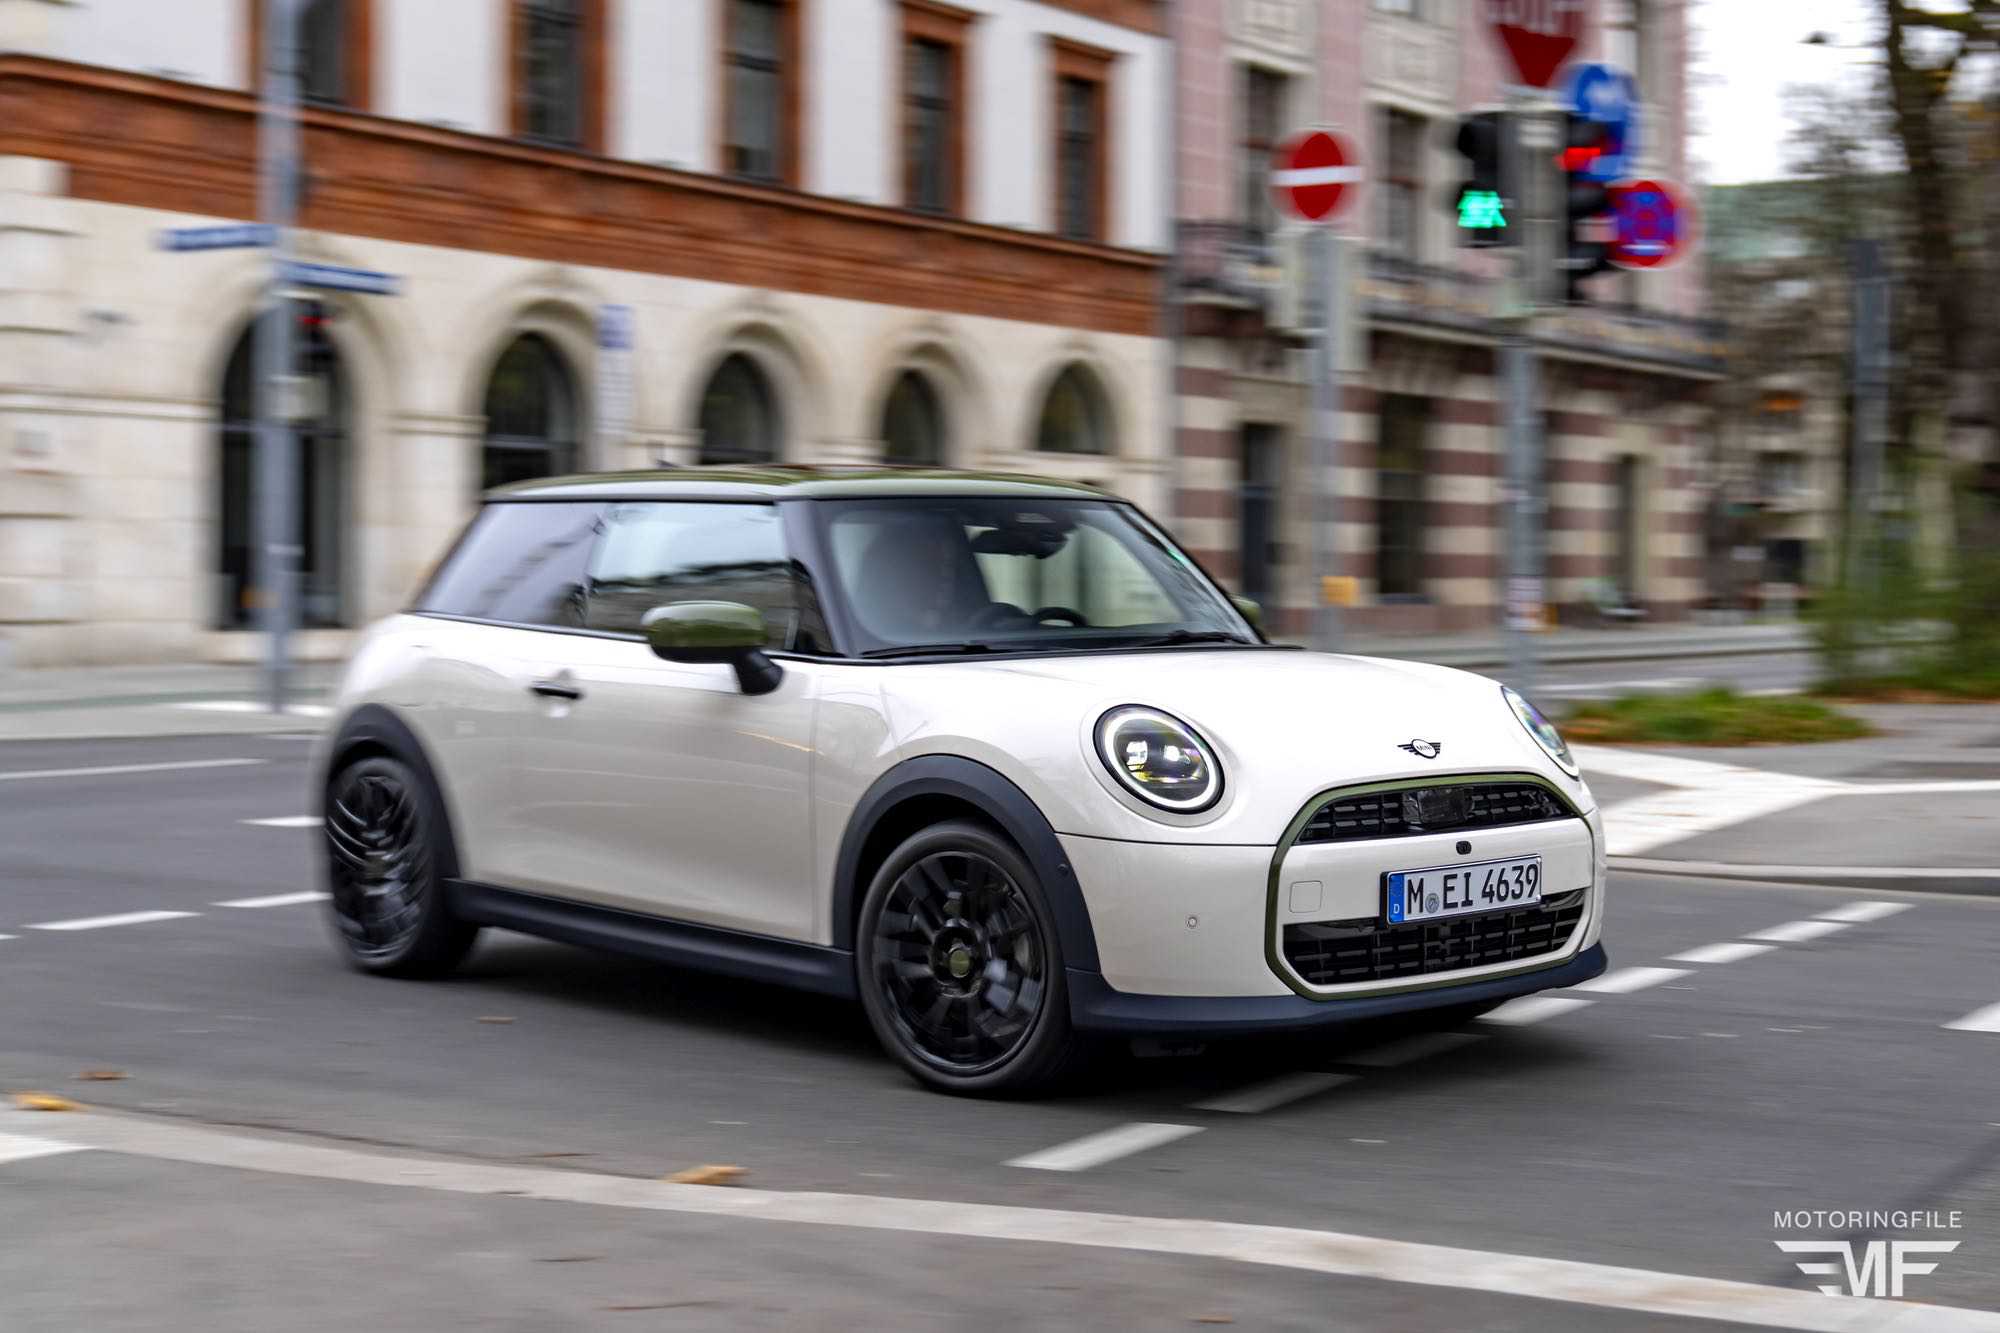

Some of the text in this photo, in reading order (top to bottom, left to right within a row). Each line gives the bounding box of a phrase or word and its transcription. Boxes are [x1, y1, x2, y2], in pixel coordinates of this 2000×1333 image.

[1407, 863, 1539, 914] M EI 4639
[1393, 903, 1400, 914] D
